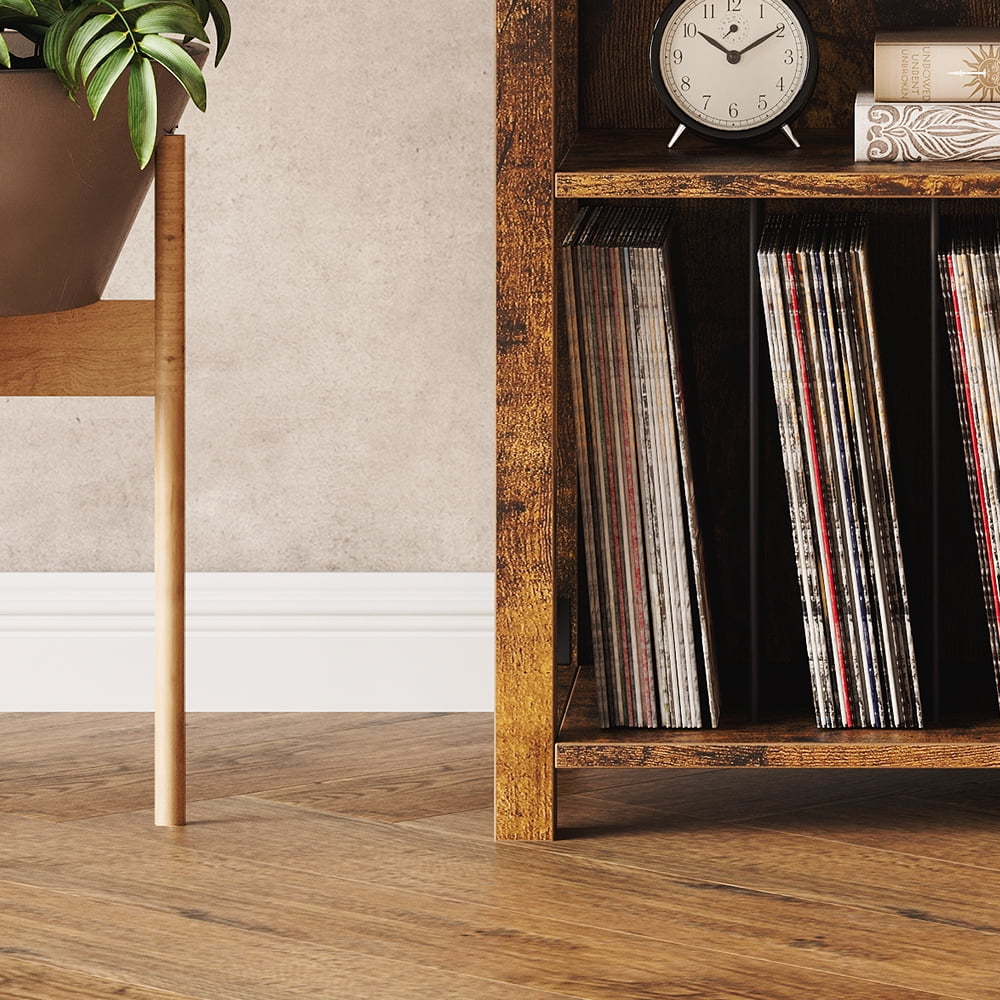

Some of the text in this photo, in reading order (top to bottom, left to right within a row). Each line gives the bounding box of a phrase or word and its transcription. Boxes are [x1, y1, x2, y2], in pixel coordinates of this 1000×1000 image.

[703, 4, 715, 19] 11
[760, 4, 764, 19] 1
[683, 22, 697, 38] 10
[776, 22, 785, 38] 2
[673, 49, 683, 64] 9
[784, 49, 794, 64] 3
[901, 49, 909, 99] UNBROKEN
[911, 54, 919, 95] UNBENT
[922, 46, 931, 101] UNBOWED
[681, 75, 691, 91] 8
[776, 76, 784, 92] 4
[702, 95, 711, 110] 7
[757, 95, 768, 110] 5
[728, 103, 739, 118] 6
